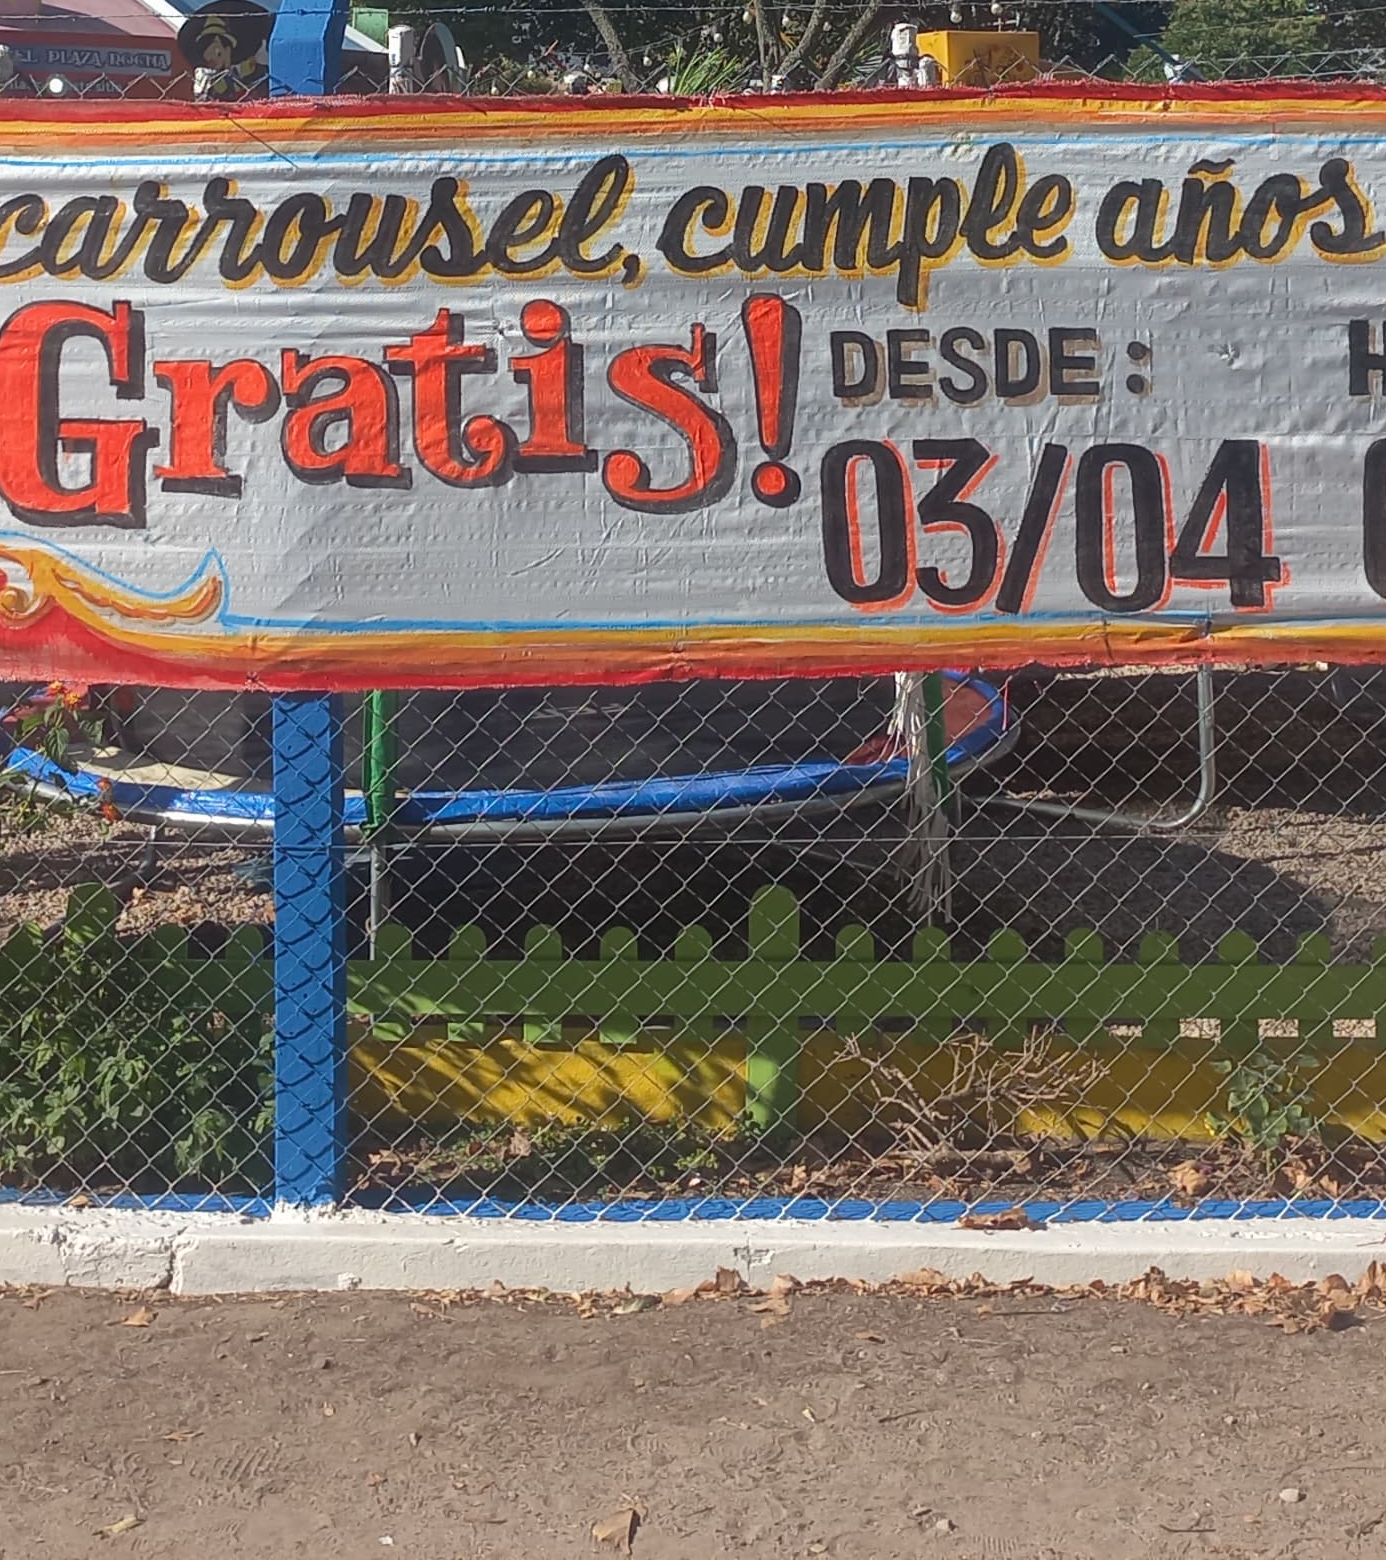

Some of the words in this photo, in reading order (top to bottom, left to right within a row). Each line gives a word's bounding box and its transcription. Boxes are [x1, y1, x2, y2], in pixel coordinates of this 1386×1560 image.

[47, 50, 101, 68] PLAZA
[109, 52, 172, 71] ROCHA
[656, 141, 1078, 311] cumple
[819, 438, 1290, 617] 03/04
